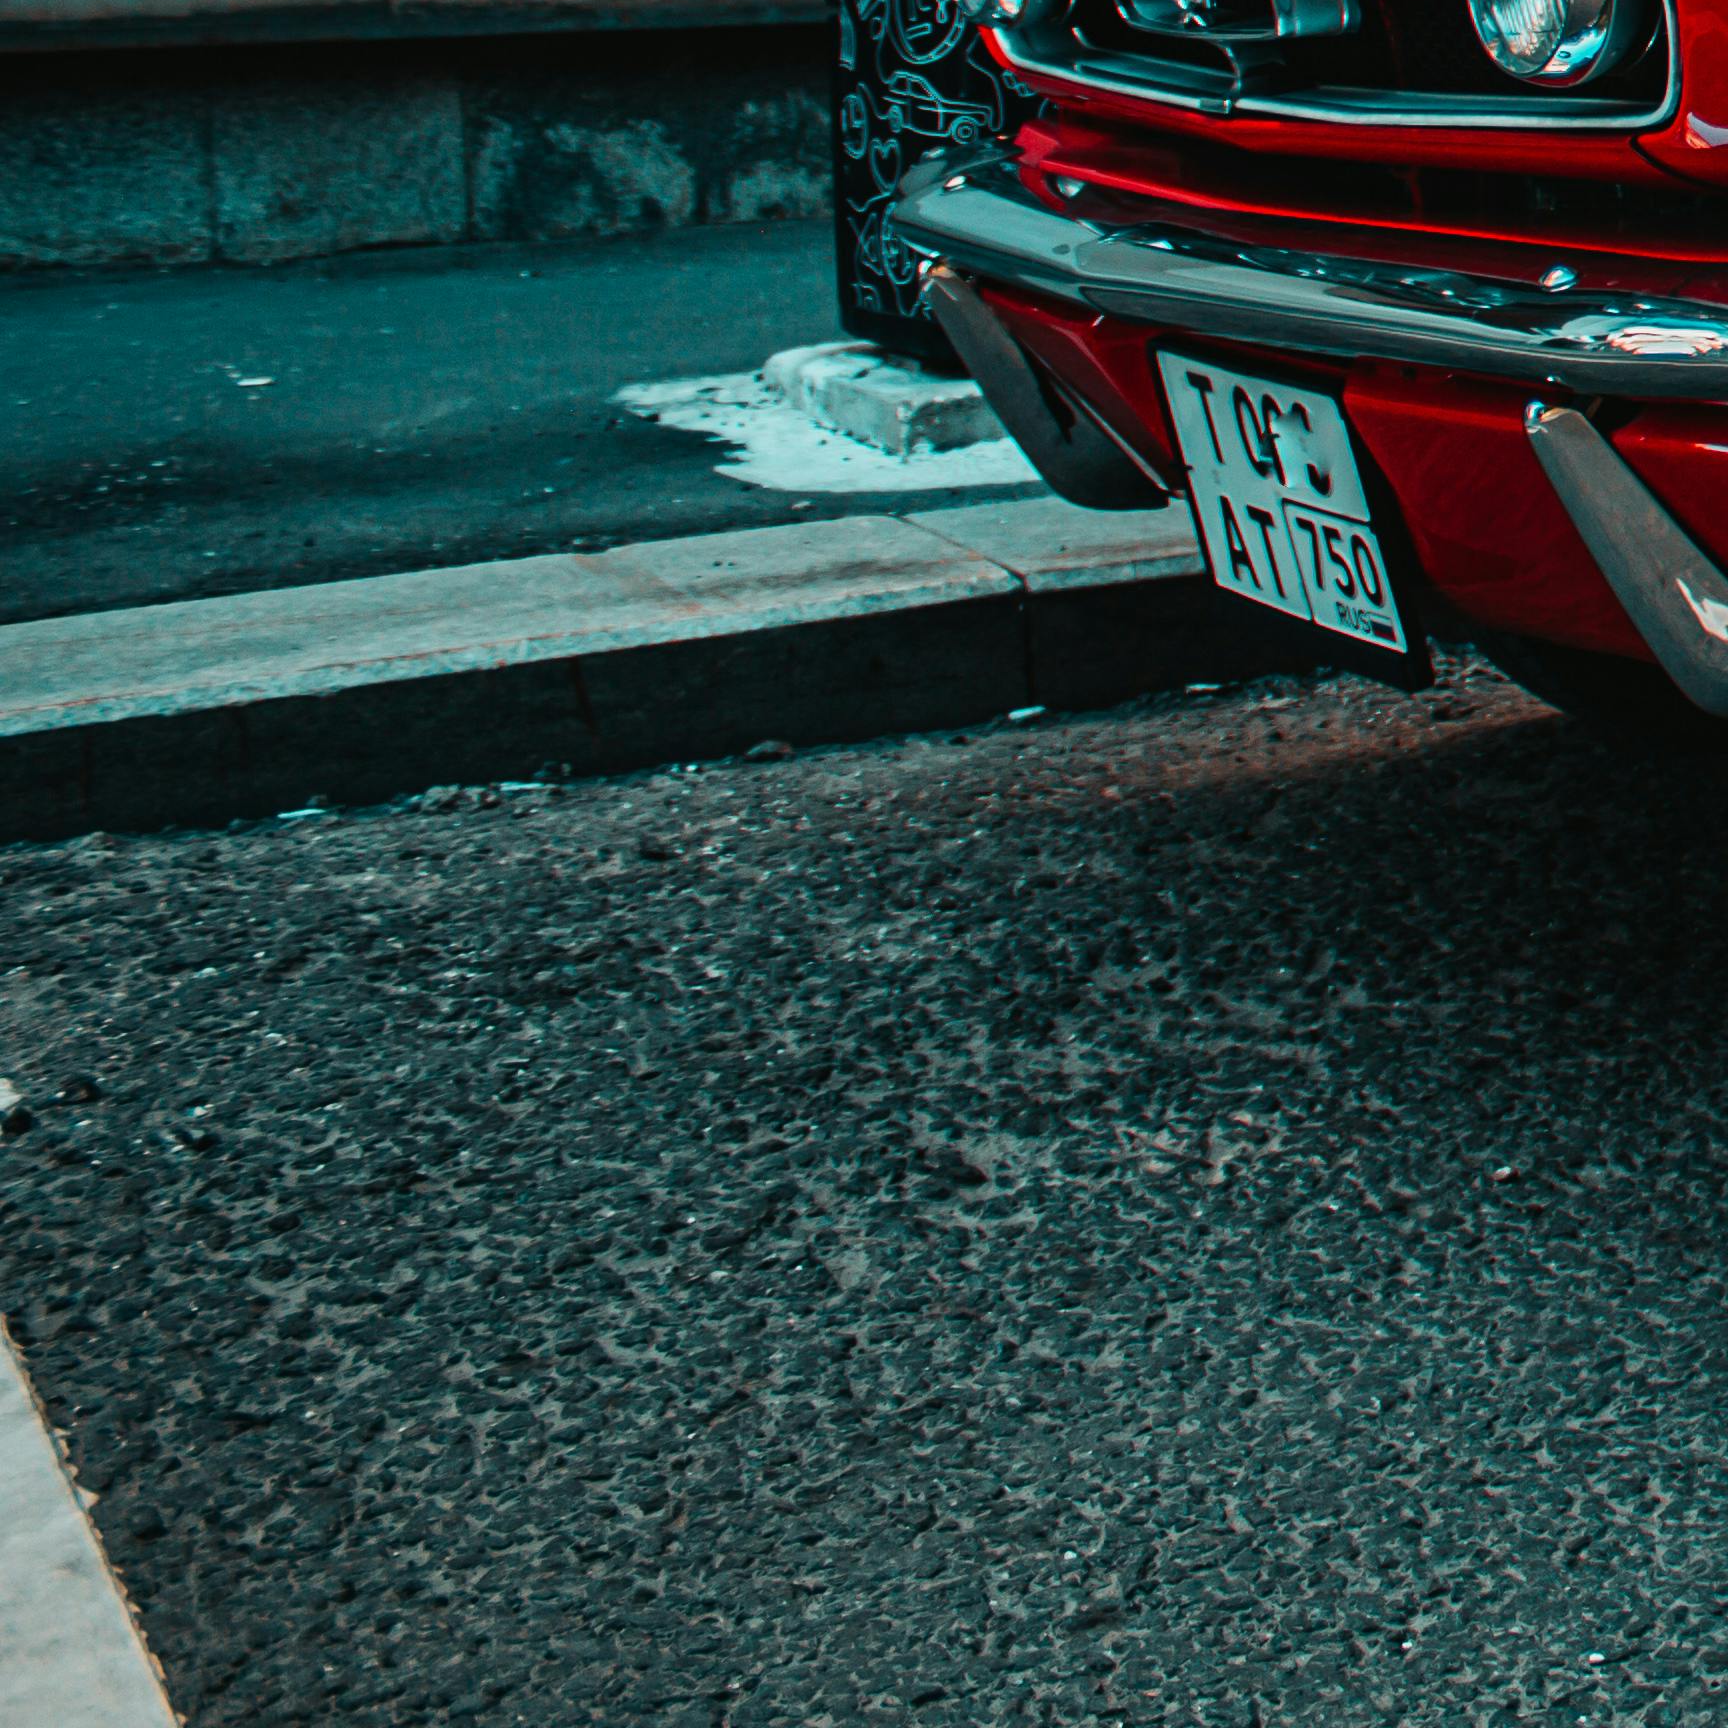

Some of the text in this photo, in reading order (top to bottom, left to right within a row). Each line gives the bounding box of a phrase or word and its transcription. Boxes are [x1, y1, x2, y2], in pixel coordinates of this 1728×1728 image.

[1219, 495, 1384, 607] AT 750
[1336, 601, 1371, 633] RUS
